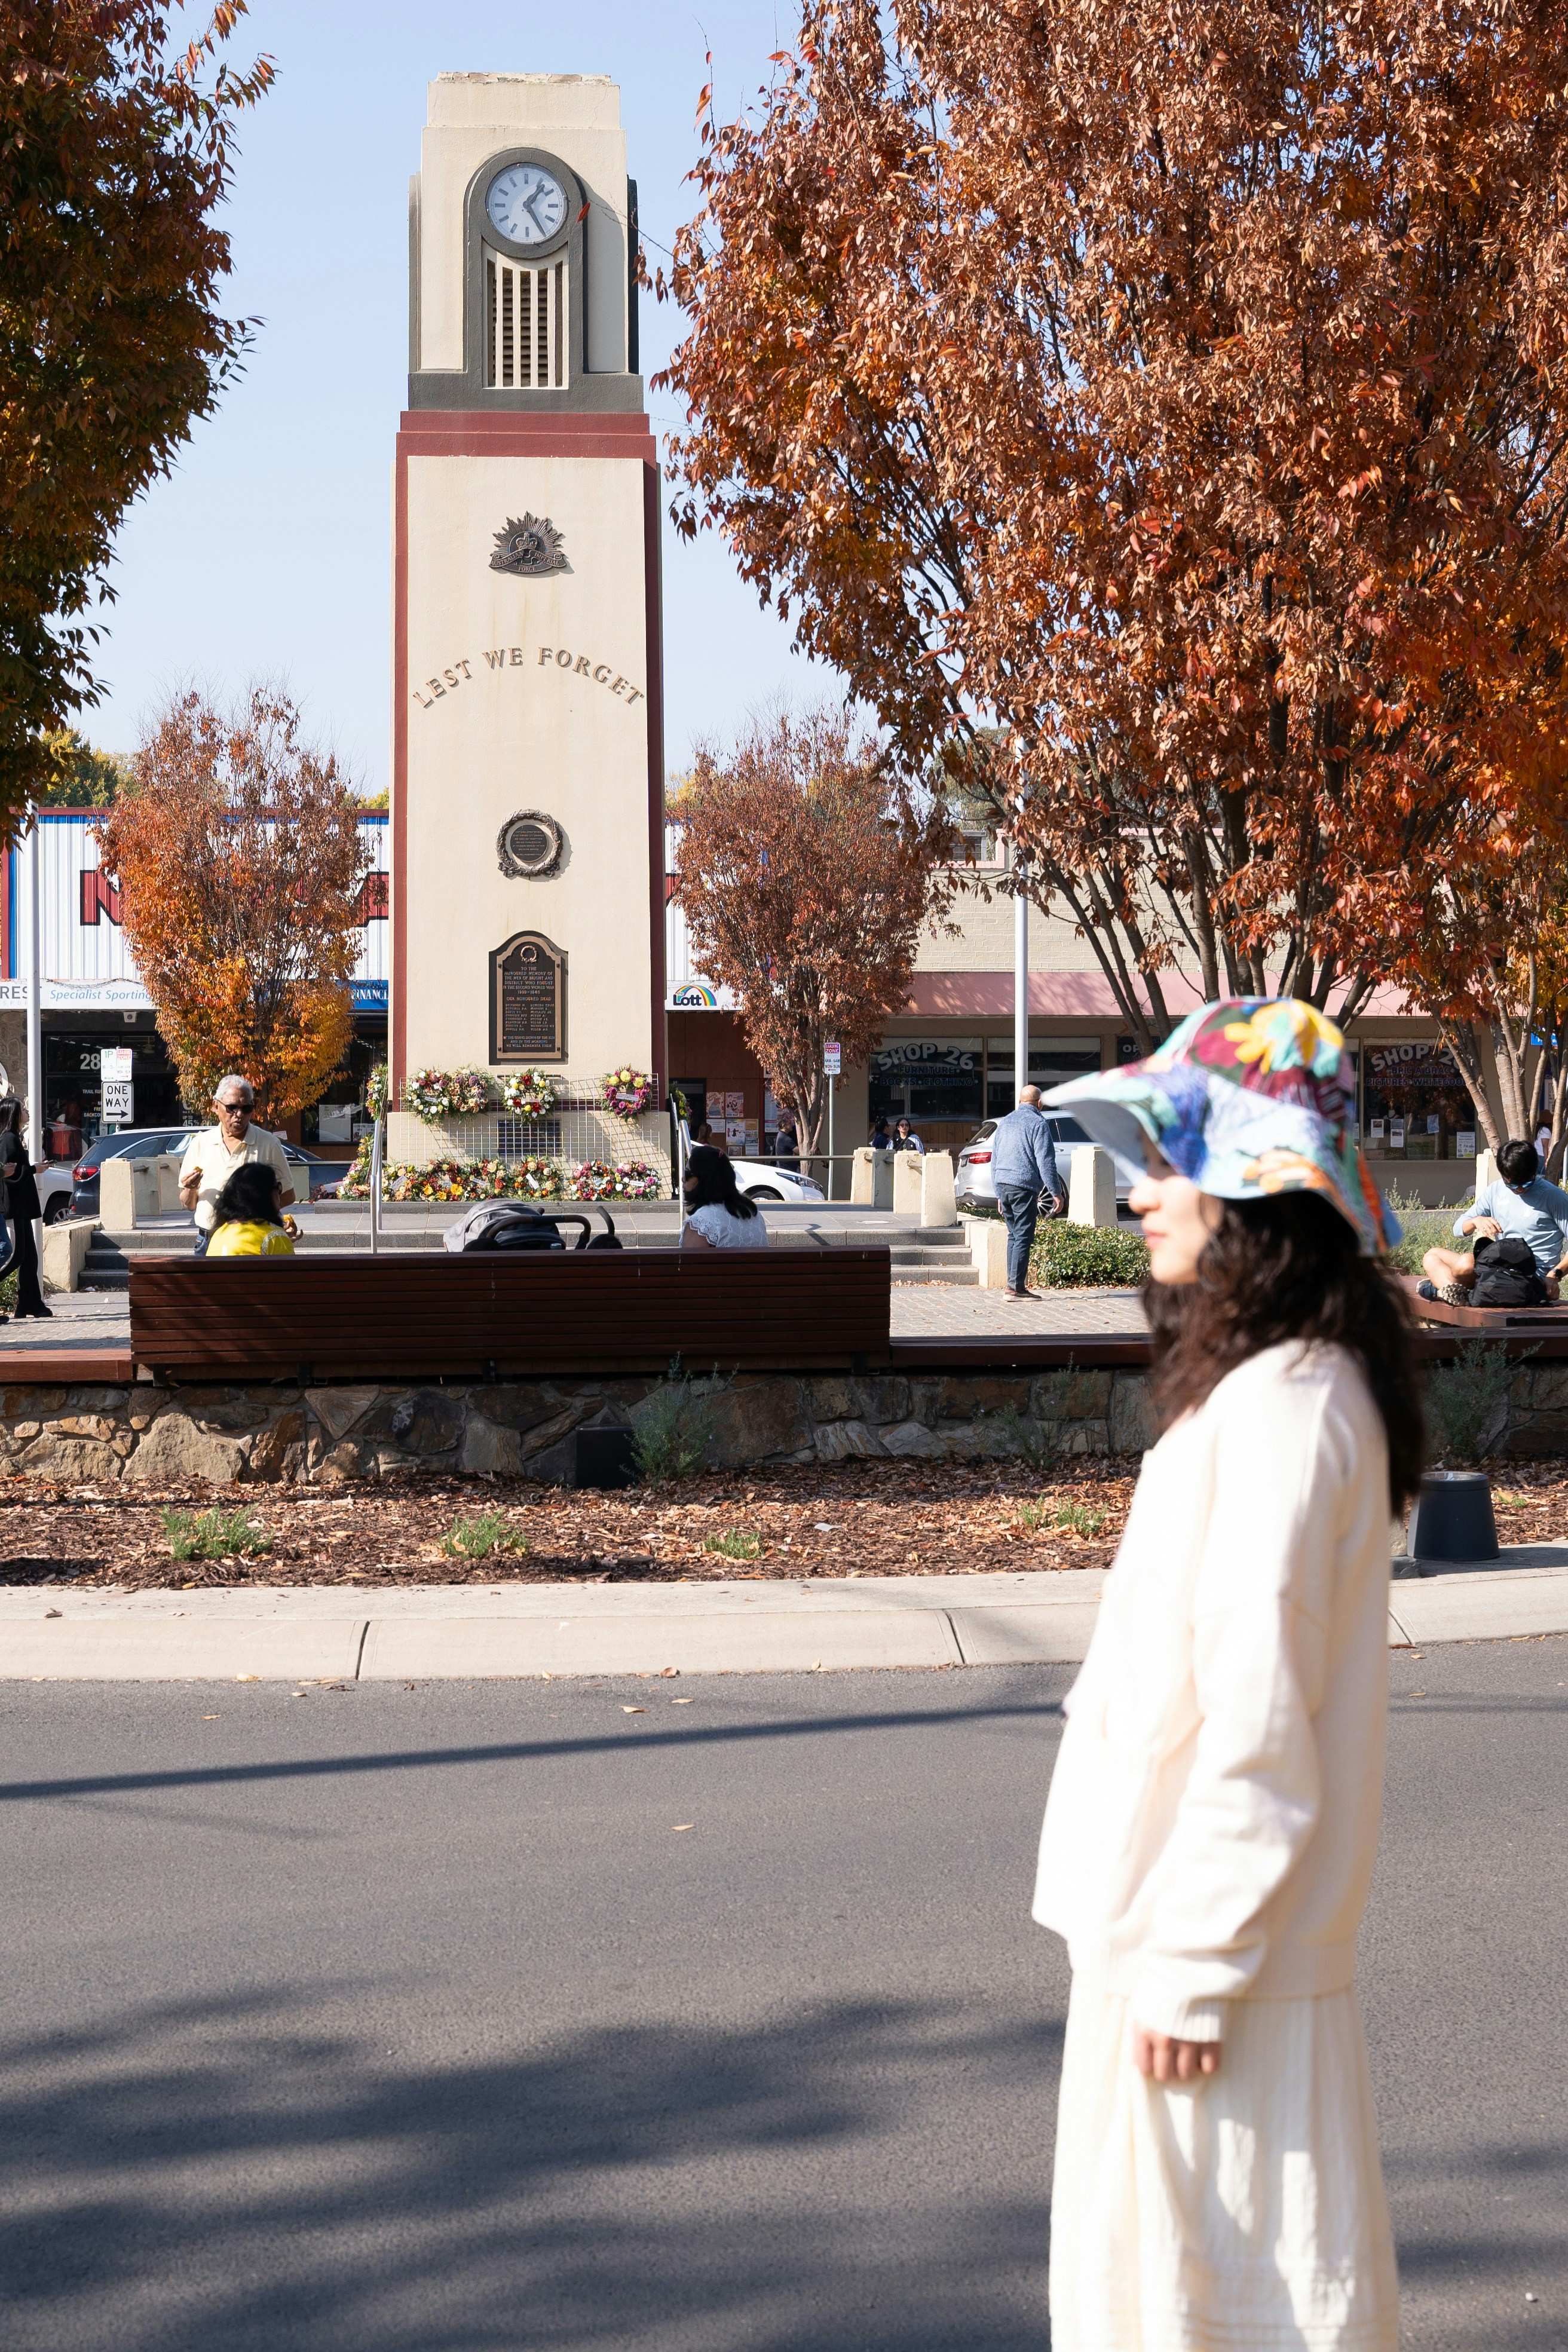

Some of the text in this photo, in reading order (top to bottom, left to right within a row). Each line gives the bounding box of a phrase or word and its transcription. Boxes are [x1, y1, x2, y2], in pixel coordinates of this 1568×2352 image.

[491, 552, 559, 566] AUSTRALIAN IMPERIAL
[412, 647, 644, 708] LEST WE FORGET
[50, 990, 151, 1002] Specialist Sporting
[350, 989, 388, 1000] FINANCI
[673, 994, 702, 1006] Lott
[79, 1054, 101, 1070] 28
[877, 1043, 974, 1071] SHOP 26
[1371, 1045, 1429, 1071] SHOP
[899, 1066, 954, 1074] FURNITURE
[1392, 1067, 1412, 1075] BRIC
[880, 1077, 973, 1086] BOOKS CLOTHING
[1366, 1077, 1465, 1086] PICTURES WHITEGOO
[107, 1086, 128, 1095] ONE
[105, 1098, 129, 1107] WAY
